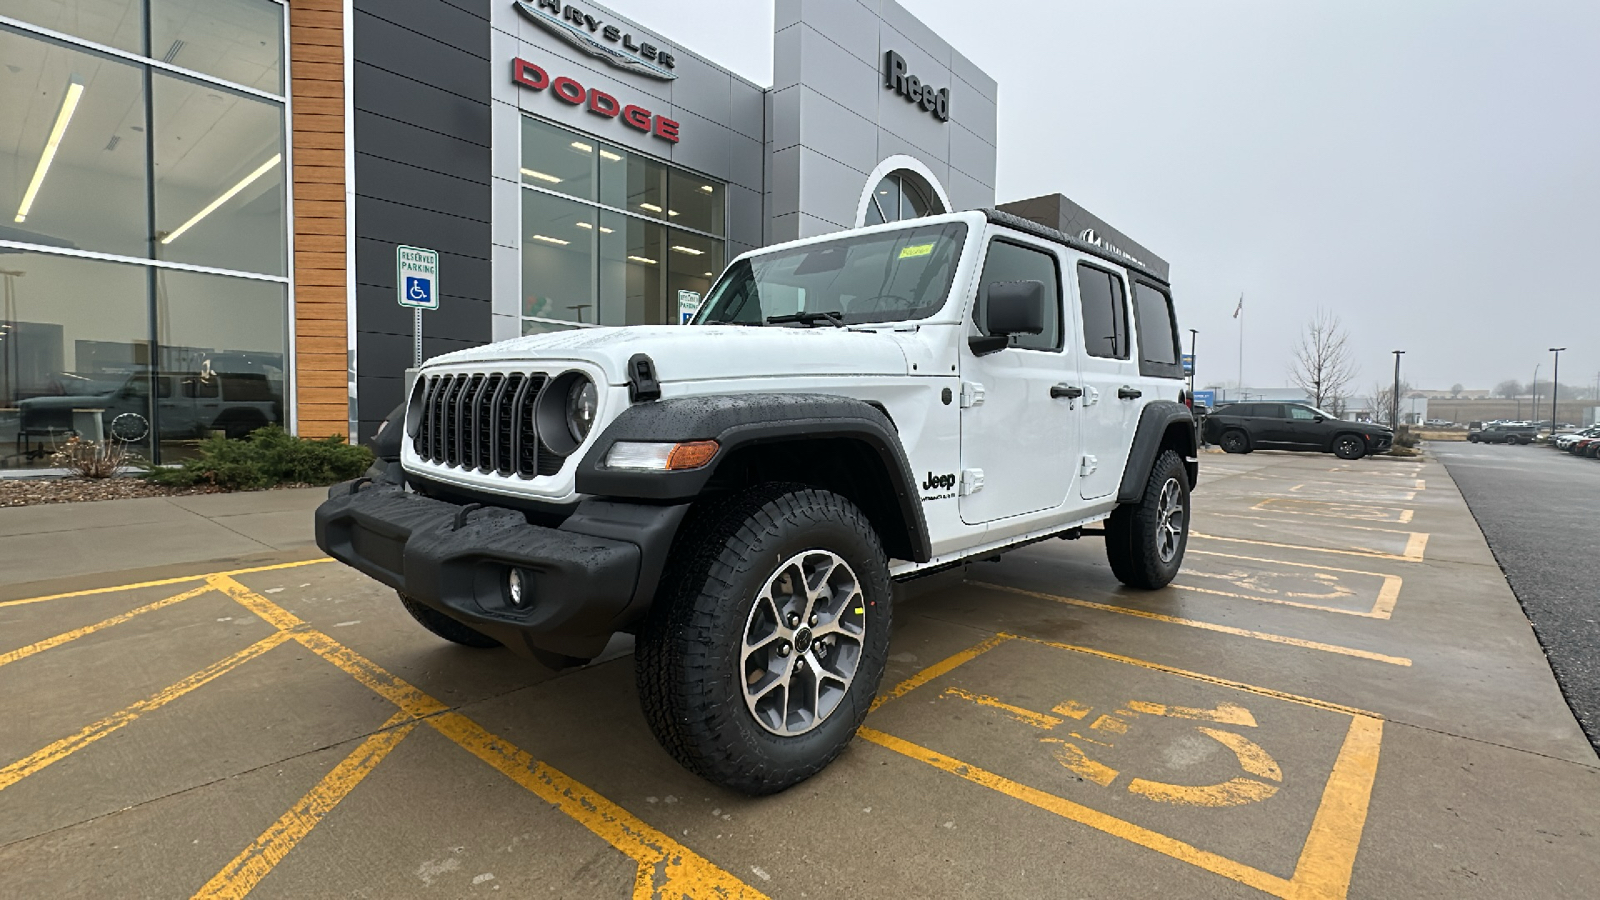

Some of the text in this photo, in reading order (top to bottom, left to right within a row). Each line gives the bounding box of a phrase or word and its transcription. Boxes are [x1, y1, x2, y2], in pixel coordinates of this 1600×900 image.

[523, 0, 675, 68] HRYSLER
[512, 57, 679, 143] DODGE
[886, 50, 949, 122] Reed
[402, 252, 434, 264] RESERVED
[402, 262, 434, 274] PARKING
[923, 472, 955, 490] Jeep
